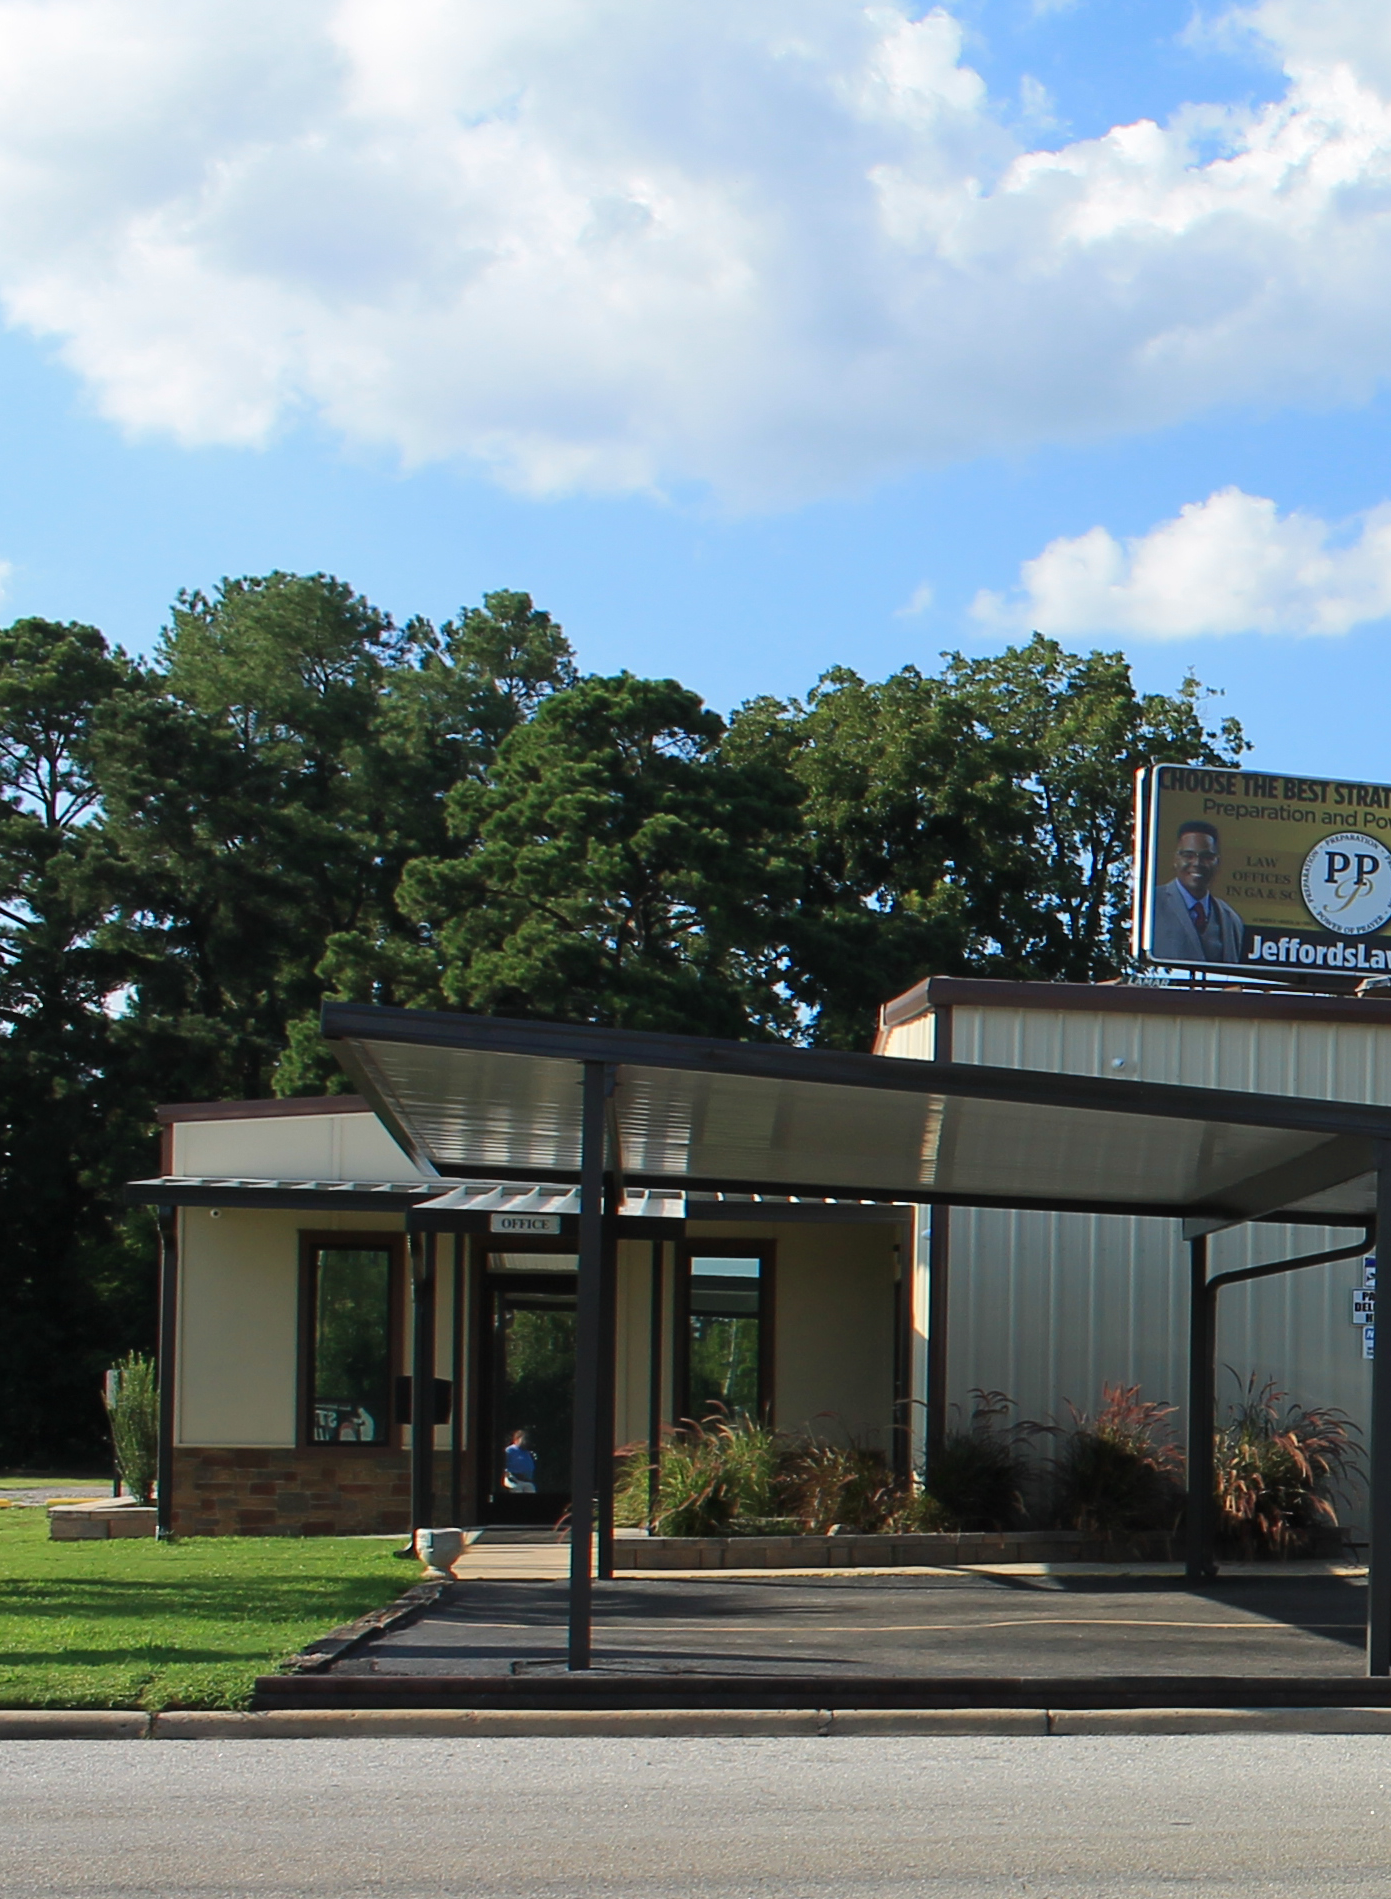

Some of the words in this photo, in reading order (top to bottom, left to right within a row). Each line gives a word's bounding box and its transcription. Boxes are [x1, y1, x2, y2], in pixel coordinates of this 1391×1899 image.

[1160, 769, 1237, 796] CHOOSE
[1242, 773, 1279, 799] THE
[1283, 778, 1330, 803] BEST
[1203, 798, 1316, 824] Preparation
[1321, 810, 1357, 827] and
[1325, 833, 1379, 850] PREPARATION
[1246, 856, 1279, 868] LAW
[1232, 871, 1292, 884] OFFICES
[1302, 850, 1319, 904] PREPARATION
[1226, 886, 1241, 896] IN
[1245, 887, 1264, 898] GA
[1267, 889, 1277, 899] &
[1280, 890, 1297, 900] SC
[1317, 911, 1342, 931] POWER
[1344, 926, 1355, 934] OF
[1356, 915, 1384, 934] PRAYER
[1127, 976, 1170, 987] LAMAR
[501, 1217, 550, 1230] OFFICE
